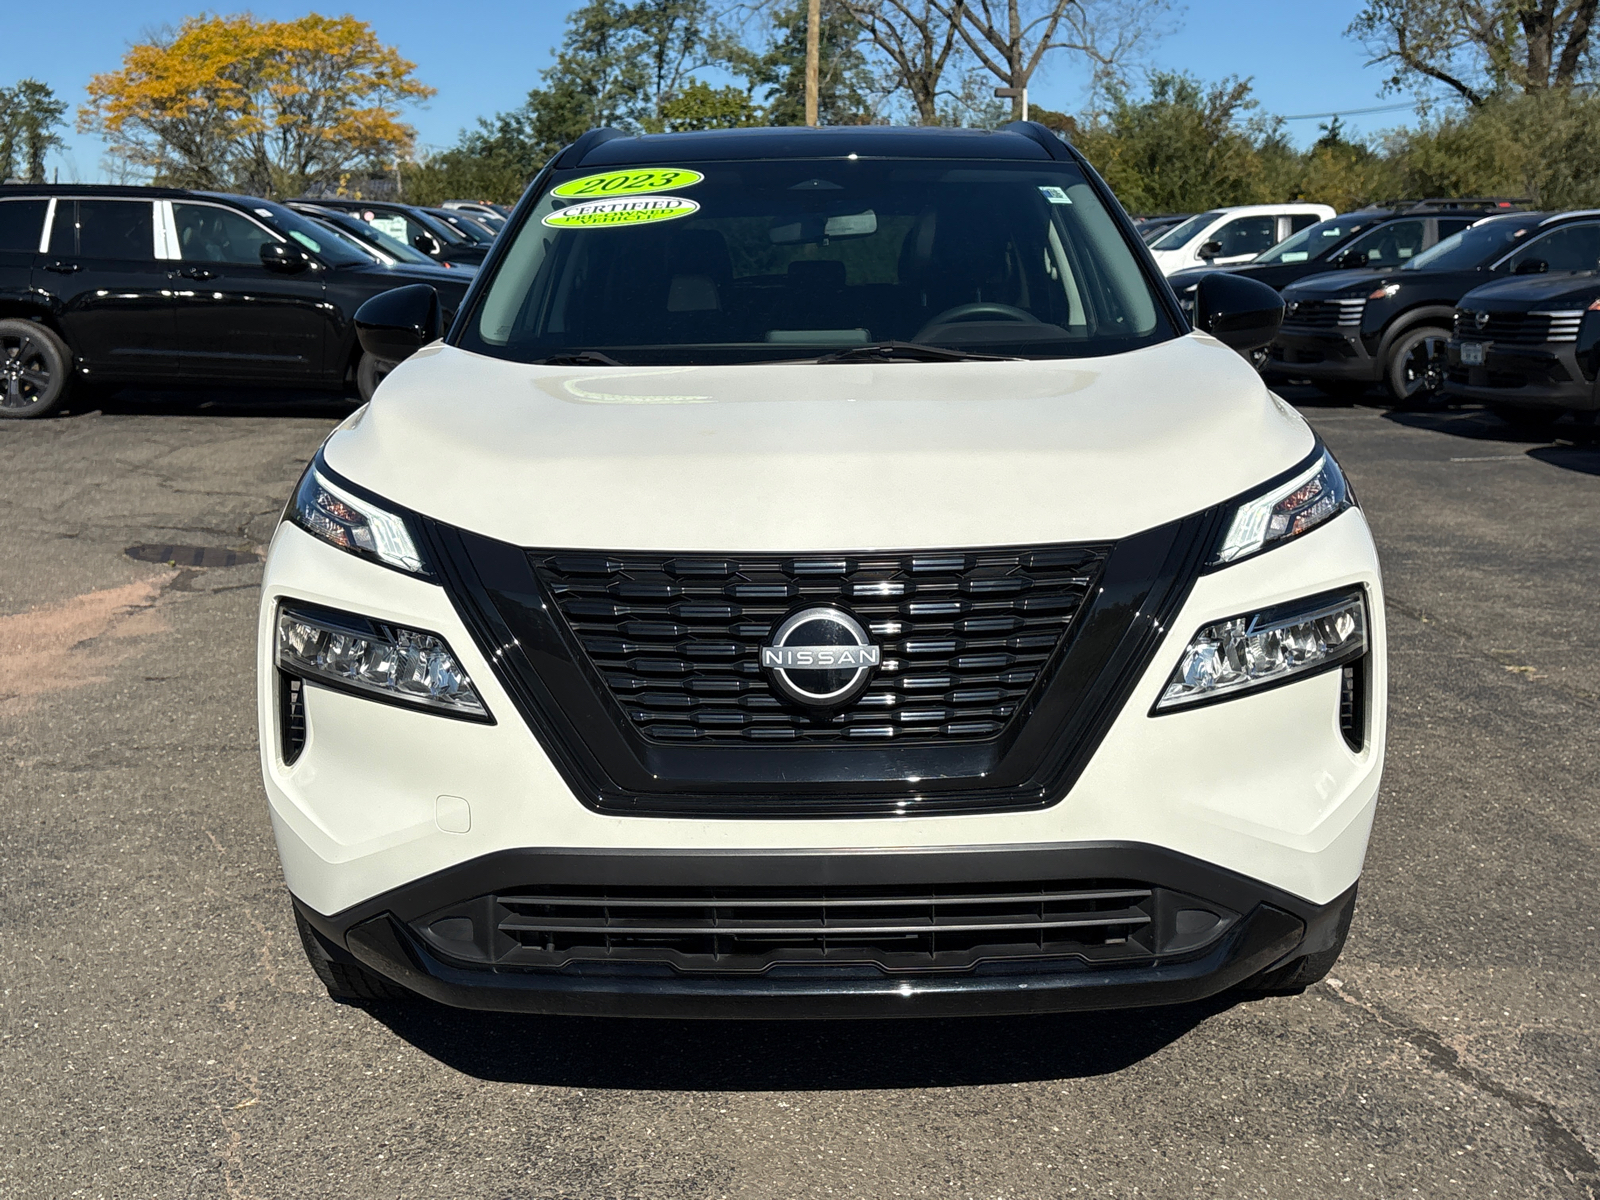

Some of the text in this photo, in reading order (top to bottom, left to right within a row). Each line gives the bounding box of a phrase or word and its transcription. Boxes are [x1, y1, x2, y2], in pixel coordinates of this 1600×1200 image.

[573, 172, 681, 195] 2023
[563, 200, 683, 217] CERTIFIED
[565, 209, 674, 222] PRE-OWNED
[580, 214, 656, 225] VEHICLE
[766, 649, 876, 665] NISSAN
